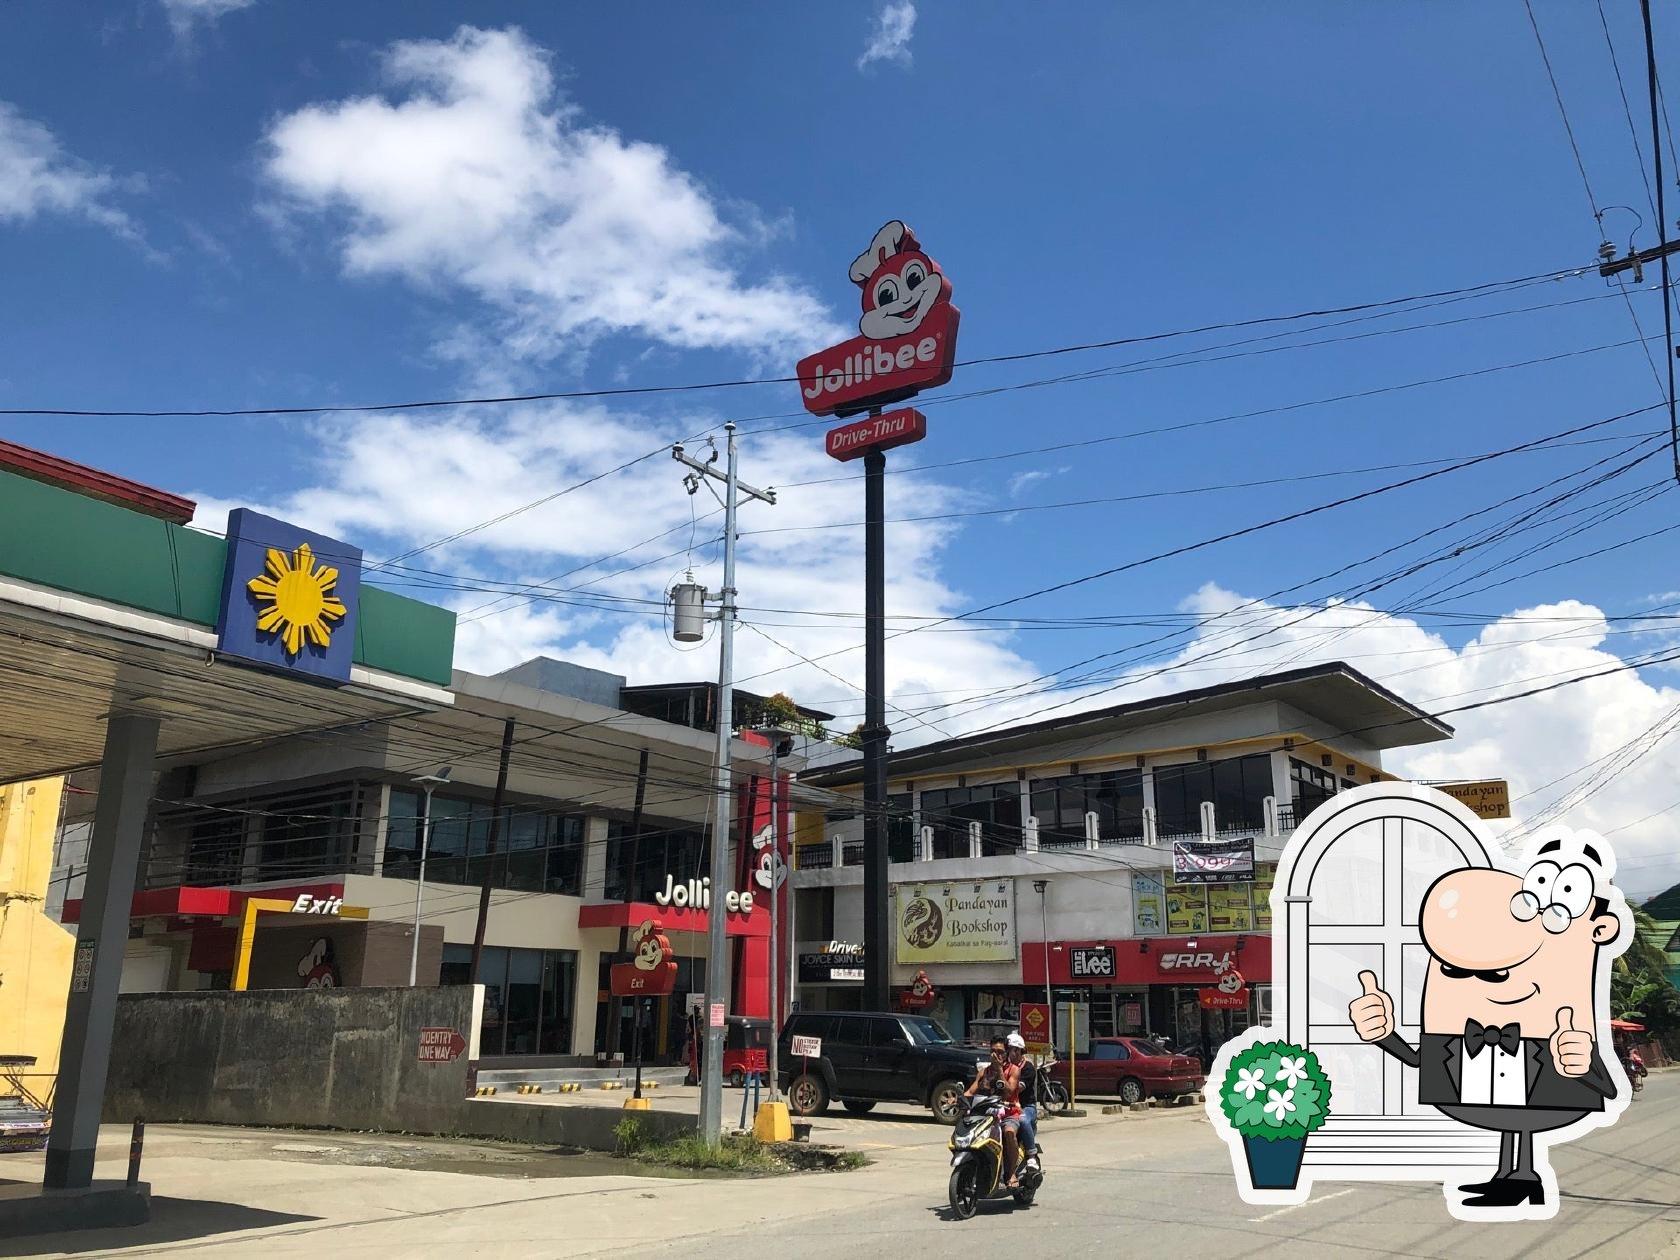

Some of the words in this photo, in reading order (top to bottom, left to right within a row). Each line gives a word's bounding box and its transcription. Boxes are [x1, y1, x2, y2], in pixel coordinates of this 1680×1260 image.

[804, 336, 937, 399] Jollibee
[832, 415, 905, 450] Drive-Thru
[656, 874, 754, 914] Jolliee
[292, 894, 343, 915] Exit
[945, 896, 1008, 915] Pandayan
[947, 919, 1008, 937] Bookshop
[829, 940, 864, 955] Drive-
[833, 954, 853, 964] SKIN
[631, 979, 645, 989] Exit
